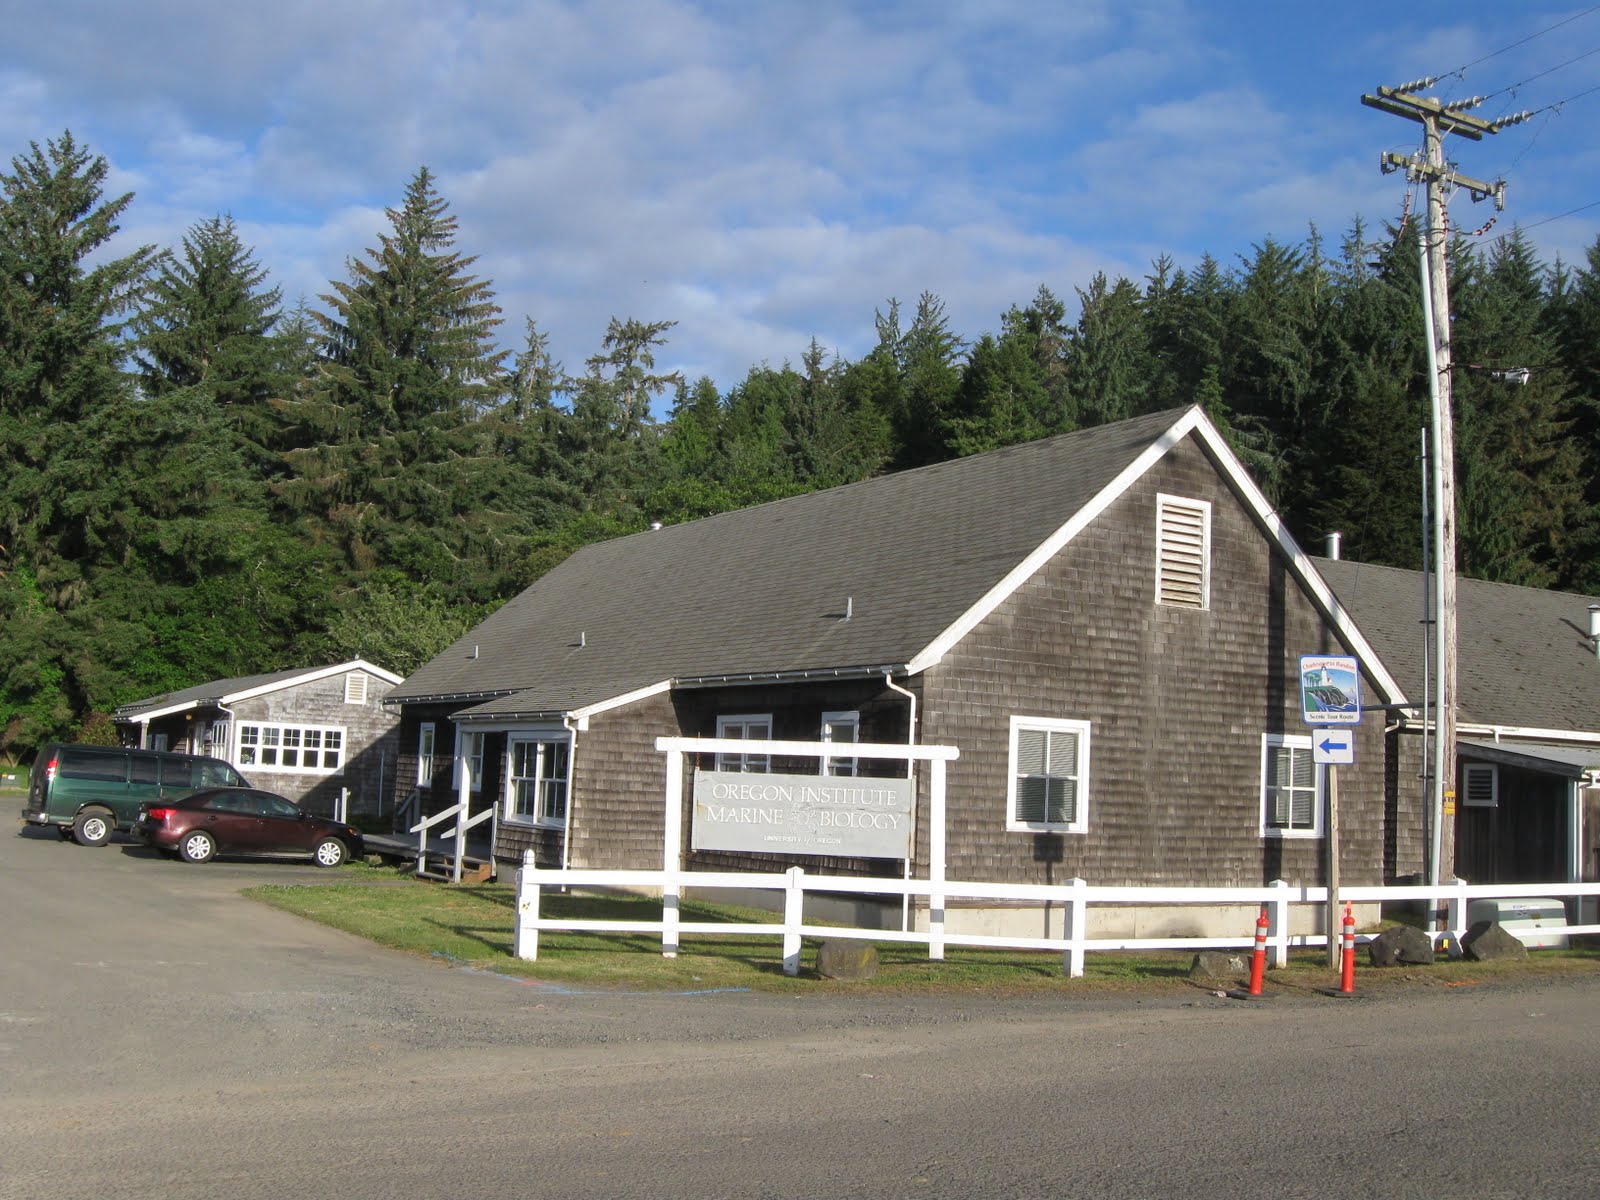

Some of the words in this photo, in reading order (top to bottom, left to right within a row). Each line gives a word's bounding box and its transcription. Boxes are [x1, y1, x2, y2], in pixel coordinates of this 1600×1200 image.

[712, 783, 793, 802] OREGON
[800, 786, 897, 806] INSTITUTE
[706, 806, 783, 825] MARINE
[819, 811, 902, 830] BIOLOGY
[764, 835, 801, 843] UNIVERSITY
[813, 837, 841, 845] OREGON
